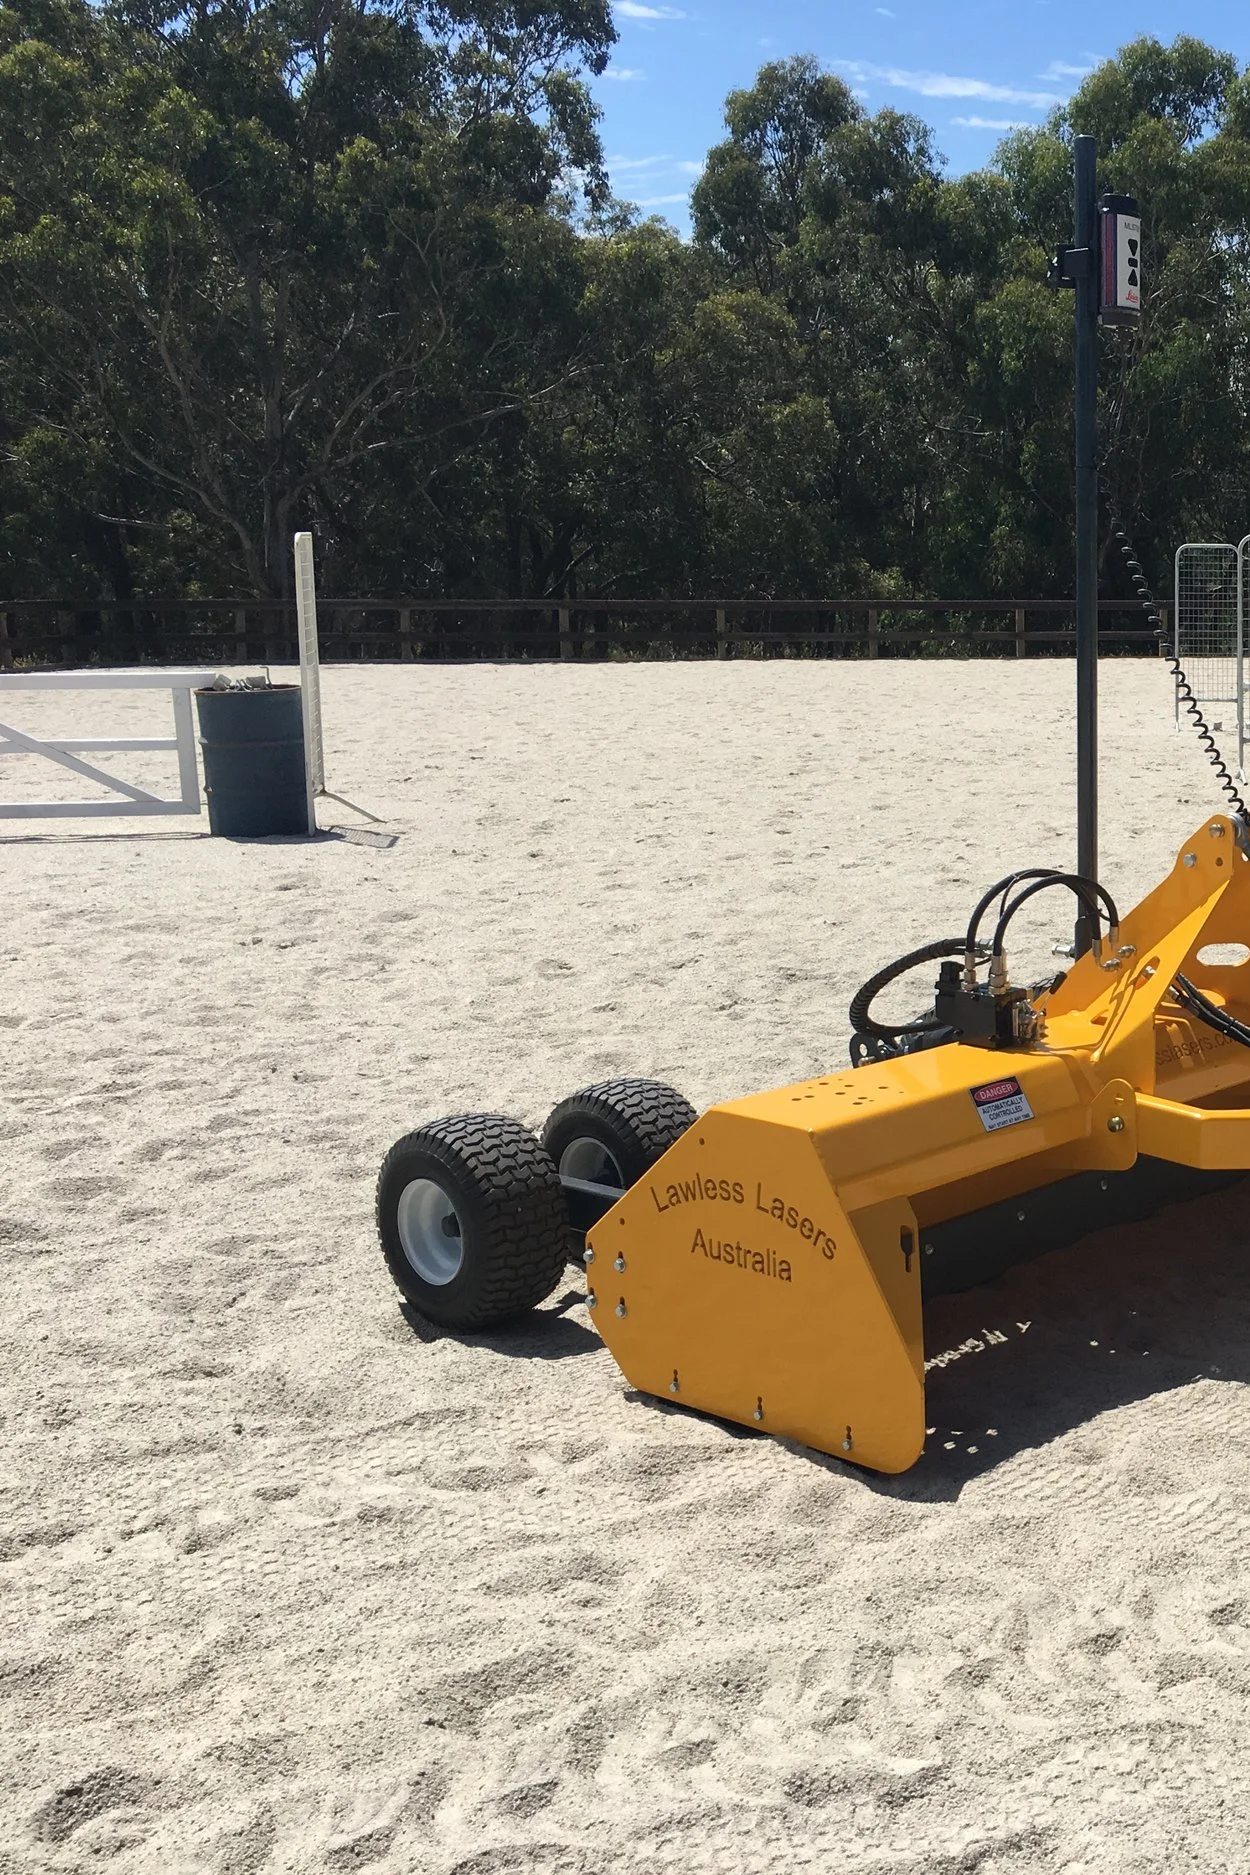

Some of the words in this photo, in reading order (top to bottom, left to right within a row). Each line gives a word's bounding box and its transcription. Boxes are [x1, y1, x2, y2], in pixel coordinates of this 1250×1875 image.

[980, 1083, 1013, 1100] DANGER
[981, 1096, 1023, 1114] AUTOMATICALLY
[988, 1105, 1023, 1121] CONTROLLED
[650, 1172, 745, 1213] Lawless
[755, 1182, 837, 1260] Lasers
[690, 1228, 792, 1282] Australia
